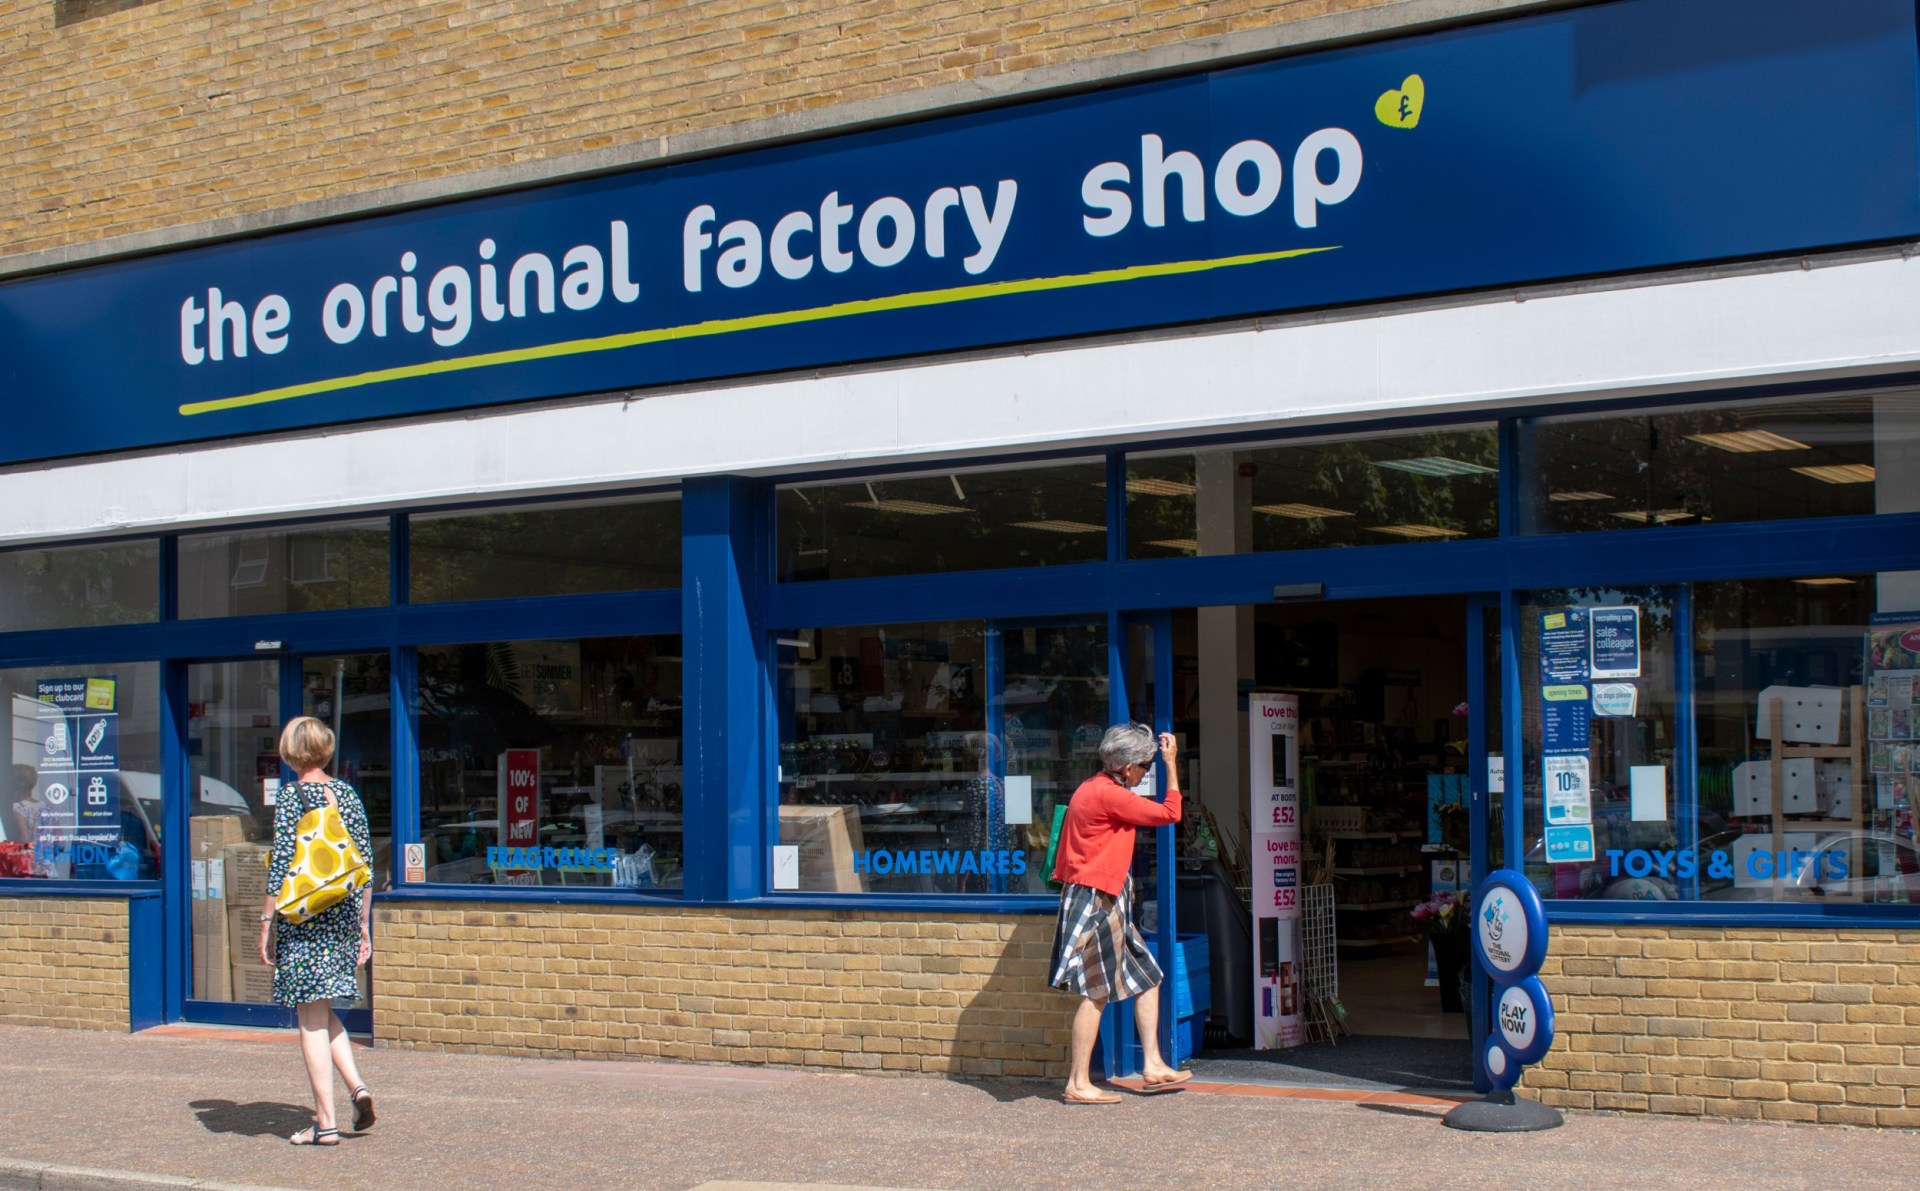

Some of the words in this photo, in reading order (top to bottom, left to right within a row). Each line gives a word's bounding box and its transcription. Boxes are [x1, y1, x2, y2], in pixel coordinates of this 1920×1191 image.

[1398, 95, 1413, 122] £
[180, 287, 291, 366] the
[322, 220, 640, 347] original
[683, 179, 1018, 292] factory
[1081, 127, 1363, 237] shop
[1595, 626, 1618, 638] sales
[1596, 637, 1635, 651] colleague
[536, 664, 572, 679] SUMMER
[38, 684, 53, 694] Sign
[54, 684, 63, 693] up
[64, 683, 72, 691] to
[72, 683, 84, 691] our
[1548, 689, 1567, 698] opening
[38, 694, 55, 702] FREE
[55, 693, 84, 702] clubcard
[1262, 705, 1285, 718] love
[509, 770, 535, 788] 100's
[1555, 772, 1581, 792] 10%
[515, 796, 529, 814] OF
[1271, 793, 1280, 802] AT
[1272, 806, 1295, 824] £52
[509, 823, 534, 841] NEW
[1267, 839, 1289, 851] love
[486, 845, 617, 869] FRAGRANCE
[853, 850, 1027, 875] HOMEWARES
[1605, 849, 1697, 879] TOYS
[1707, 849, 1735, 879] &
[1746, 850, 1849, 880] GIFTS
[1274, 888, 1296, 906] £52
[1488, 947, 1511, 958] NATIONAL
[1492, 942, 1502, 950] THE
[1490, 955, 1511, 963] LOTTERY
[1501, 1003, 1527, 1021] PLAY
[1501, 1017, 1526, 1034] NOW
